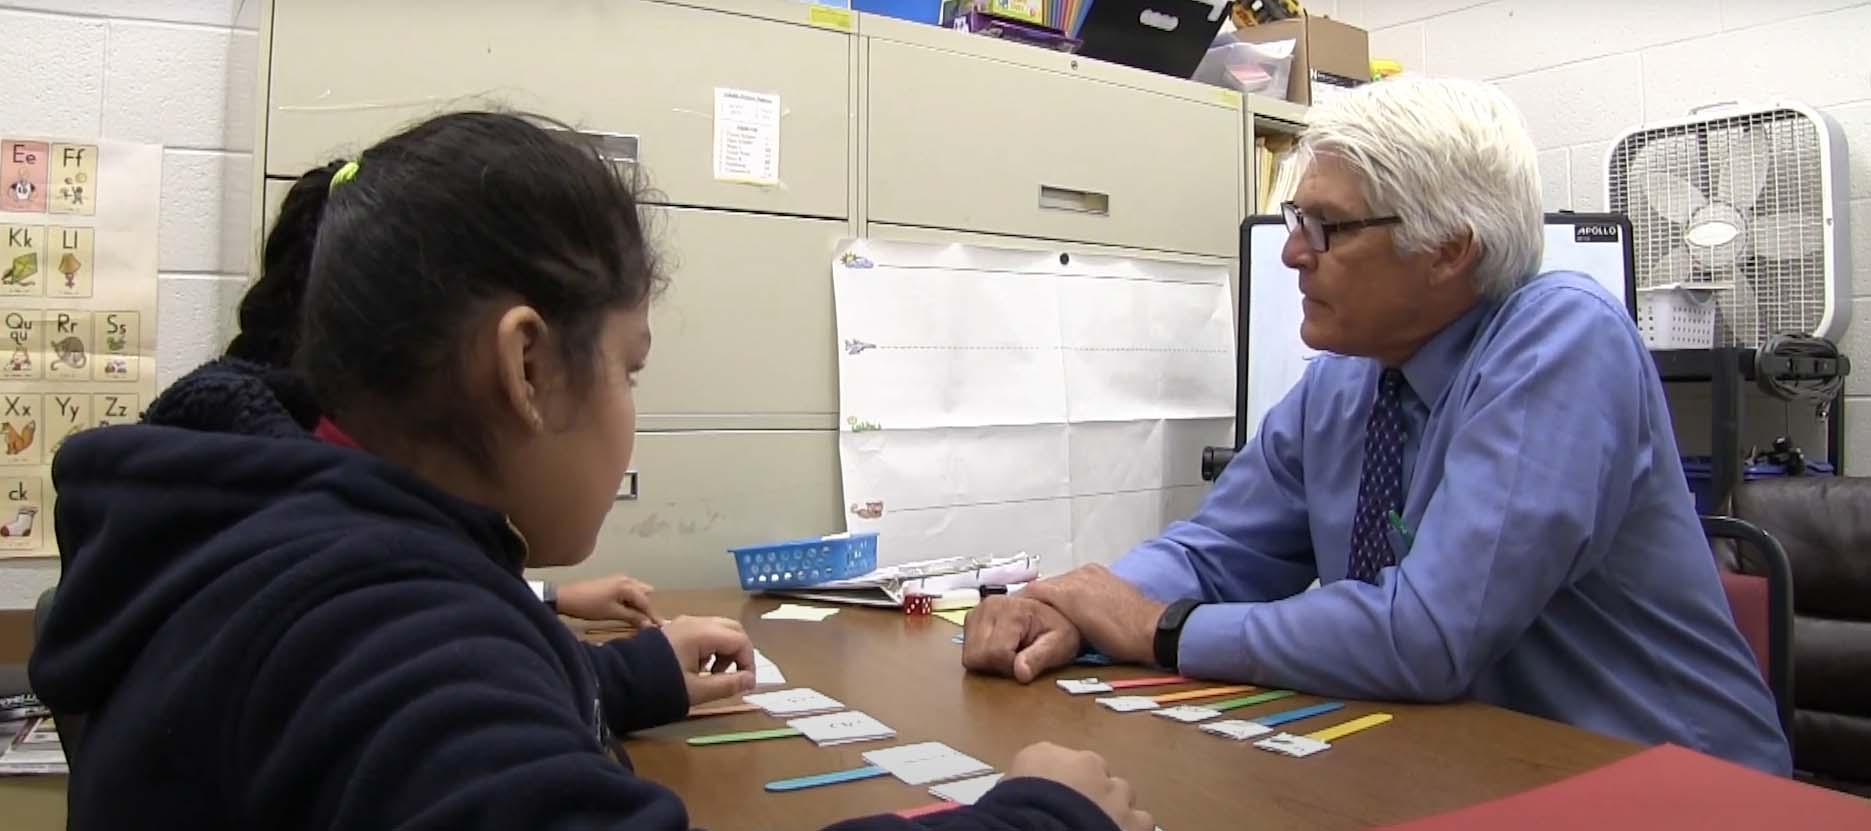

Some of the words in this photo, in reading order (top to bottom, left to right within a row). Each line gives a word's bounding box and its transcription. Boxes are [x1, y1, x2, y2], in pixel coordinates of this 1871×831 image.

[13, 144, 36, 165] Ee
[63, 148, 85, 168] Ff
[9, 228, 33, 249] Kk
[63, 230, 78, 249] Ll
[1577, 226, 1616, 235] APOLLO
[5, 312, 32, 330] Qu
[57, 314, 79, 333] Rr
[107, 315, 127, 335] Ss
[10, 330, 27, 345] qu
[5, 397, 31, 416] Xx
[56, 397, 79, 422] Yy
[105, 397, 127, 417] Zz
[8, 482, 27, 501] ck
